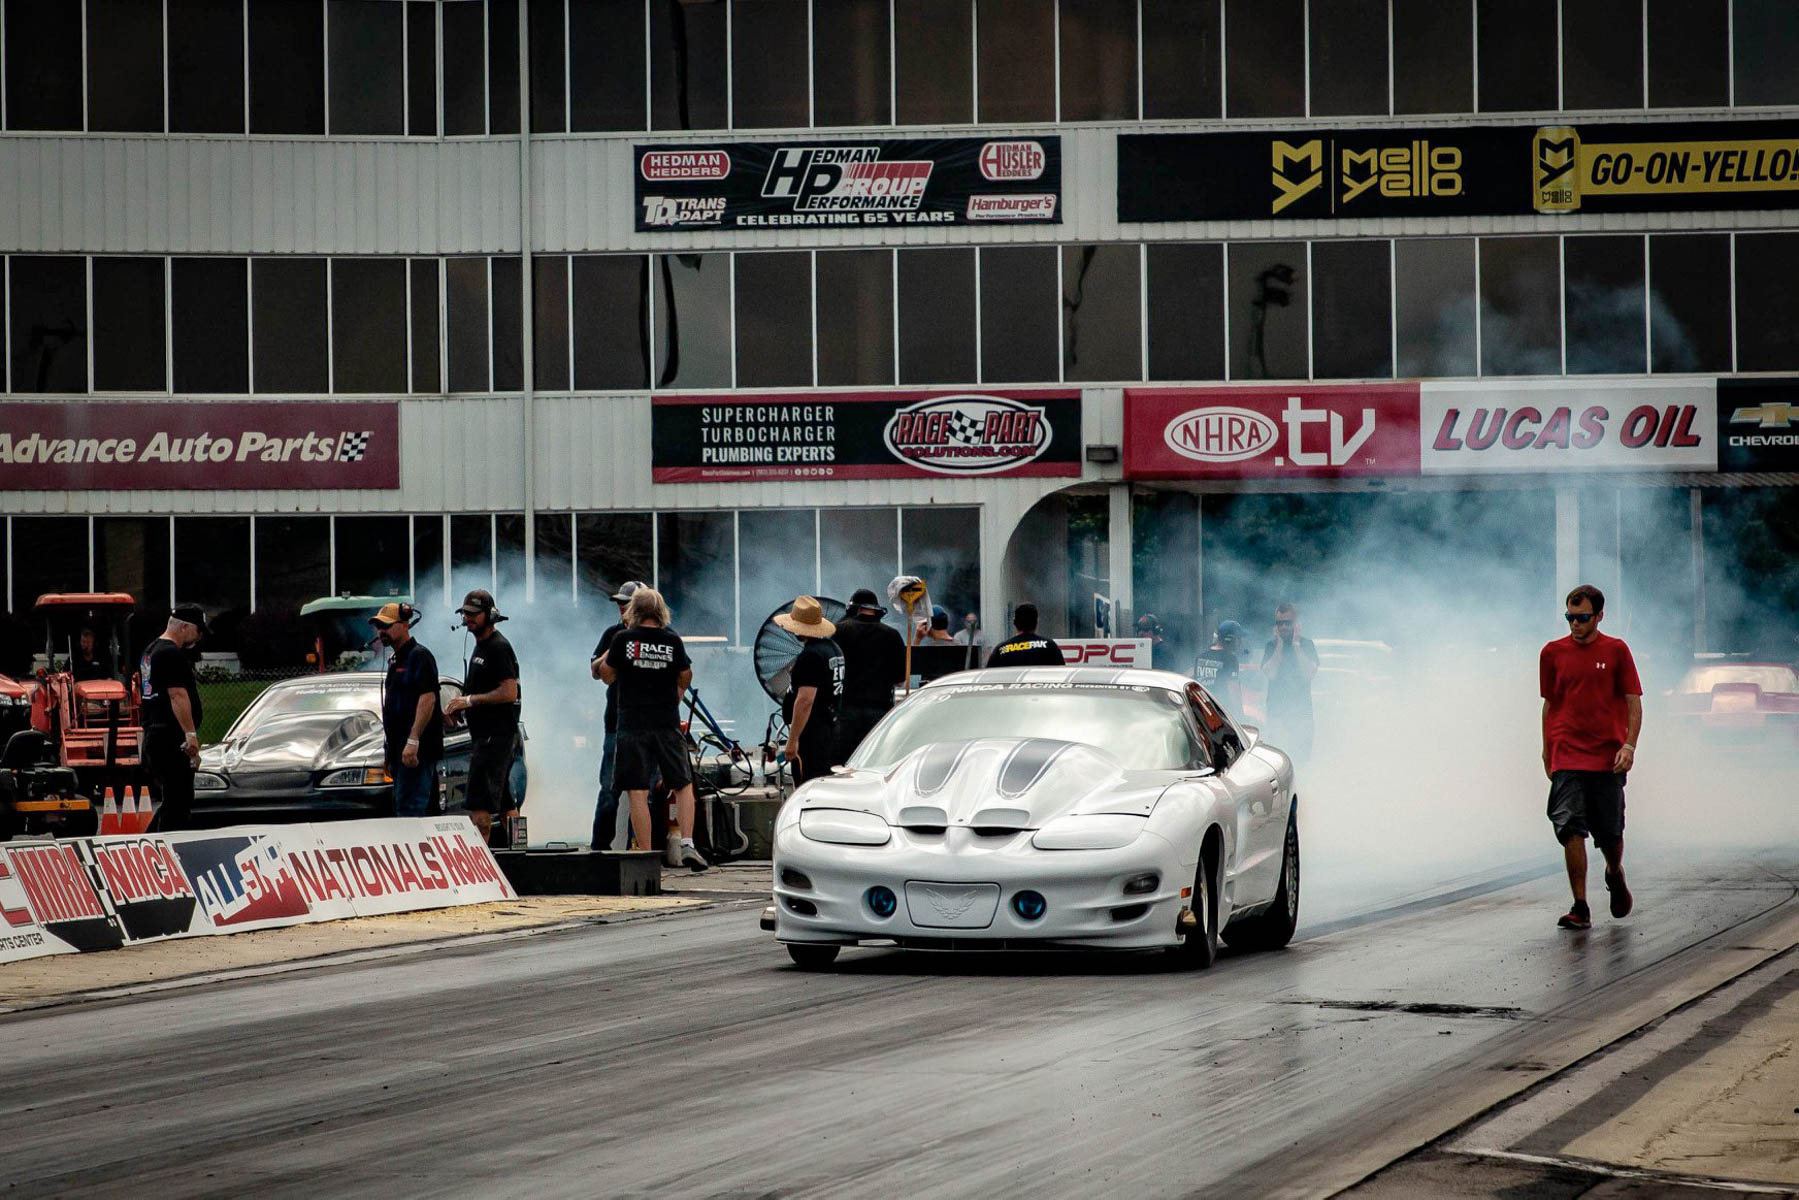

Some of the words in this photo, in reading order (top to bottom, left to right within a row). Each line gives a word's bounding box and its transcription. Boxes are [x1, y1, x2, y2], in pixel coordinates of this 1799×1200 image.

[651, 155, 721, 167] HEDMAN
[651, 167, 722, 176] HEDDERS
[678, 197, 727, 210] TRANS
[972, 195, 1053, 212] Hamburger's
[680, 210, 725, 221] DAPT
[737, 211, 860, 226] CELEBRATING
[864, 212, 889, 223] 65
[892, 211, 955, 223] YEARS
[701, 406, 835, 424] SUPERCHARGER
[701, 426, 836, 443] TURBOCHARGER
[896, 412, 953, 444] RACE
[984, 410, 1041, 444] PART
[1182, 416, 1262, 451] NHRA
[1433, 405, 1610, 450] LUCAS
[1620, 405, 1701, 448] OIL
[0, 433, 136, 463] Advance
[138, 431, 235, 463] Auto
[235, 431, 335, 462] Parts
[702, 447, 774, 463] PLUMBING
[777, 446, 836, 461] EXPERTS
[901, 446, 1038, 458] SOLUTIONS.COM
[640, 643, 674, 655] RACE
[96, 841, 192, 903] NMCA
[288, 842, 449, 903] NATIONALS
[432, 835, 509, 898] Holley
[8, 847, 105, 922] NMRA
[13, 933, 45, 948] CENTER
